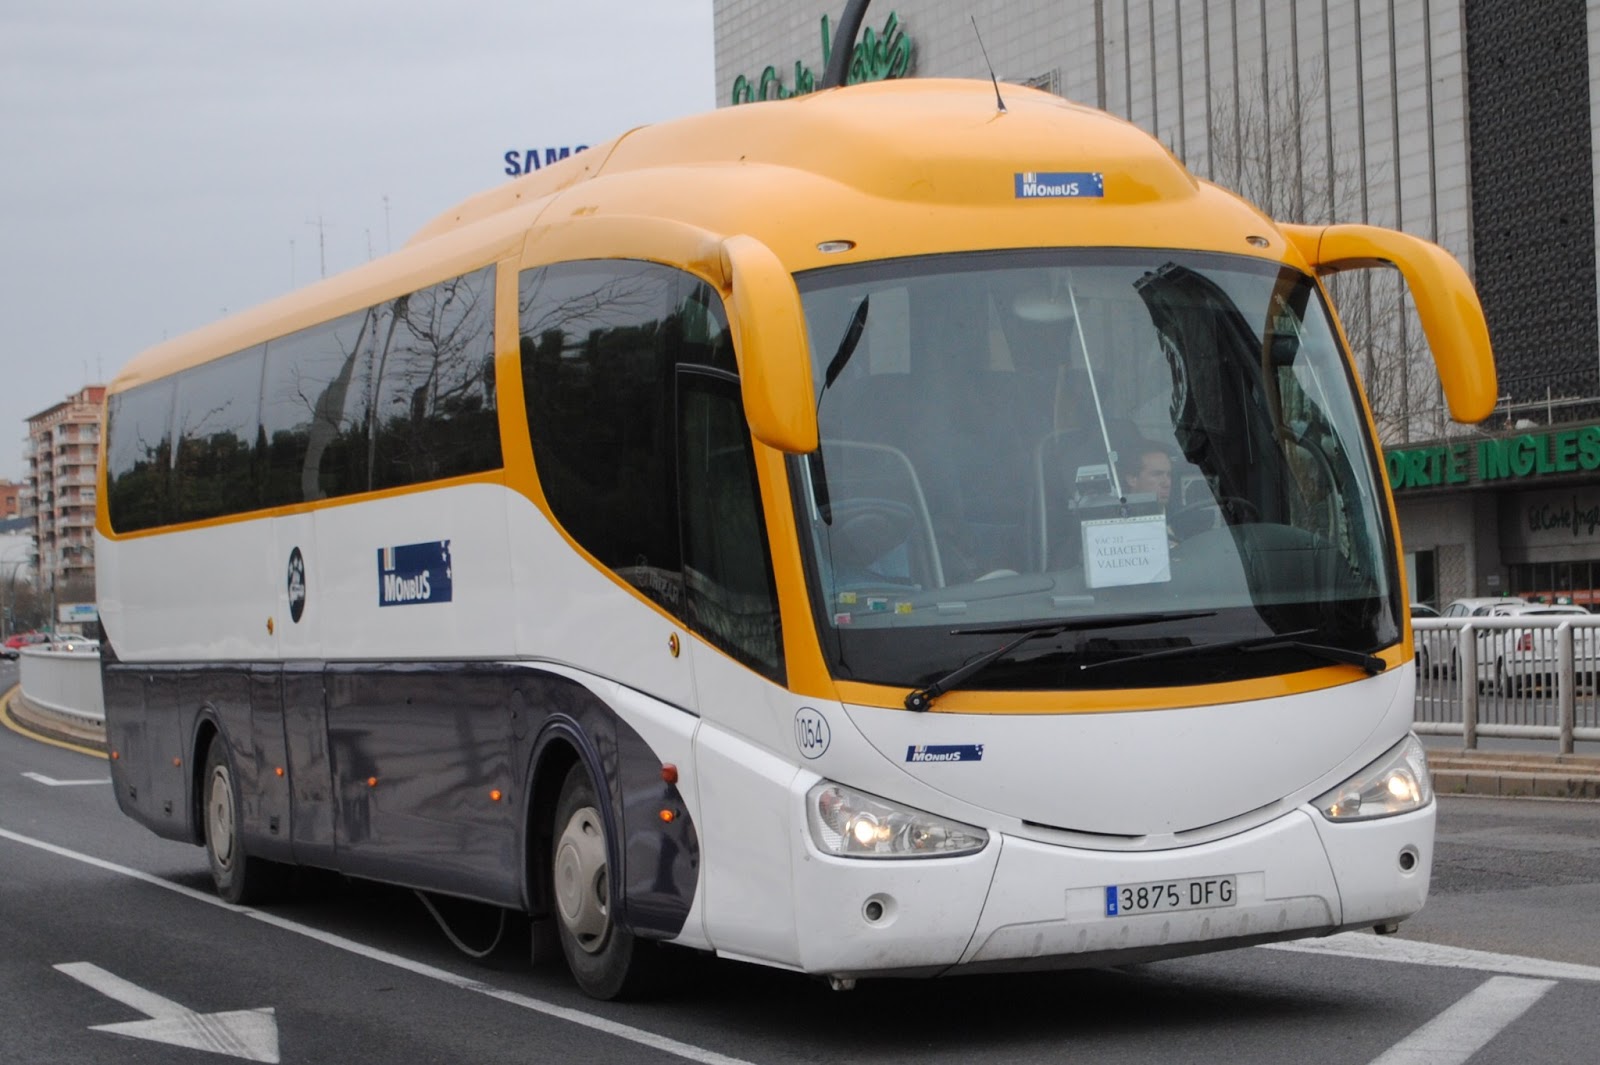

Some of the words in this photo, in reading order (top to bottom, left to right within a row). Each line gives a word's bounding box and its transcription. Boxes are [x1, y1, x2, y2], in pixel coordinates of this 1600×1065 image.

[504, 145, 590, 177] SAM
[1475, 425, 1600, 481] INGLES
[1572, 495, 1600, 537] Ingl
[1097, 557, 1150, 569] VALENCIA
[796, 719, 823, 749] 1054
[1121, 884, 1180, 911] 3875
[1189, 879, 1233, 906] DFG
